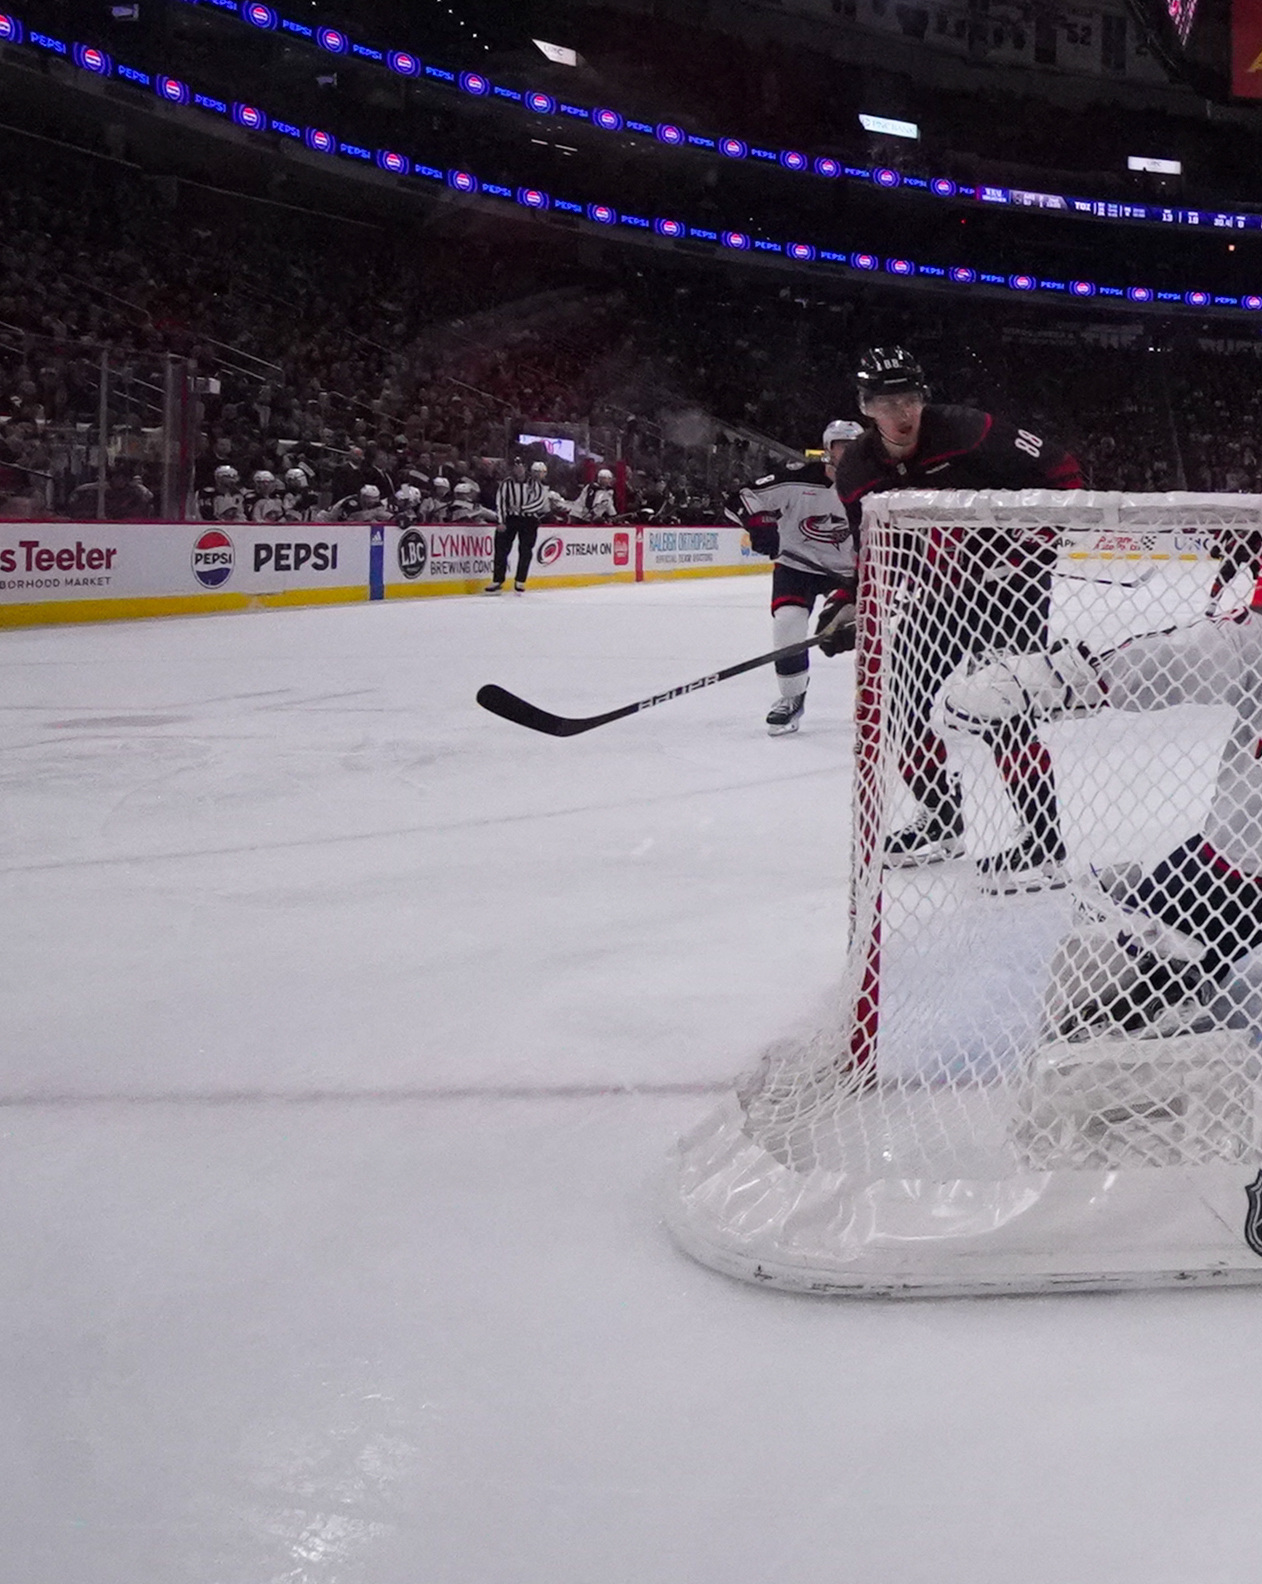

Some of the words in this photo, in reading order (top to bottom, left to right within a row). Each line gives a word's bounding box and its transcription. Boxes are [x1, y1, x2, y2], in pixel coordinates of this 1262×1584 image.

[283, 20, 312, 36] PEPSI
[353, 44, 382, 59] PEPSI
[426, 67, 454, 80] PEPSI
[494, 87, 521, 100] PEPSI
[561, 105, 588, 117] PEPSI
[30, 32, 66, 53] PEPSI
[118, 65, 149, 84] PEPSI
[195, 94, 226, 113] PEPSI
[272, 120, 300, 138] PEPSI
[341, 144, 370, 158] PEPSI
[415, 164, 442, 178] PEPSI
[482, 184, 511, 196] PEPSI
[555, 200, 582, 212] PEPSI
[621, 215, 649, 227] PEPSI
[755, 241, 781, 251] PEPSI
[884, 358, 900, 370] 88
[1014, 429, 1043, 458] 88
[0, 548, 16, 573] s
[19, 541, 117, 572] Teeter
[253, 543, 338, 573] PEPSI
[401, 542, 425, 566] LBC
[430, 534, 493, 558] LYNNWO
[566, 543, 597, 556] STREAM
[600, 543, 611, 555] ON
[194, 552, 232, 565] PEPSI
[430, 560, 470, 576] BREWING
[679, 554, 691, 563] TEAM
[65, 576, 111, 587] MARKET
